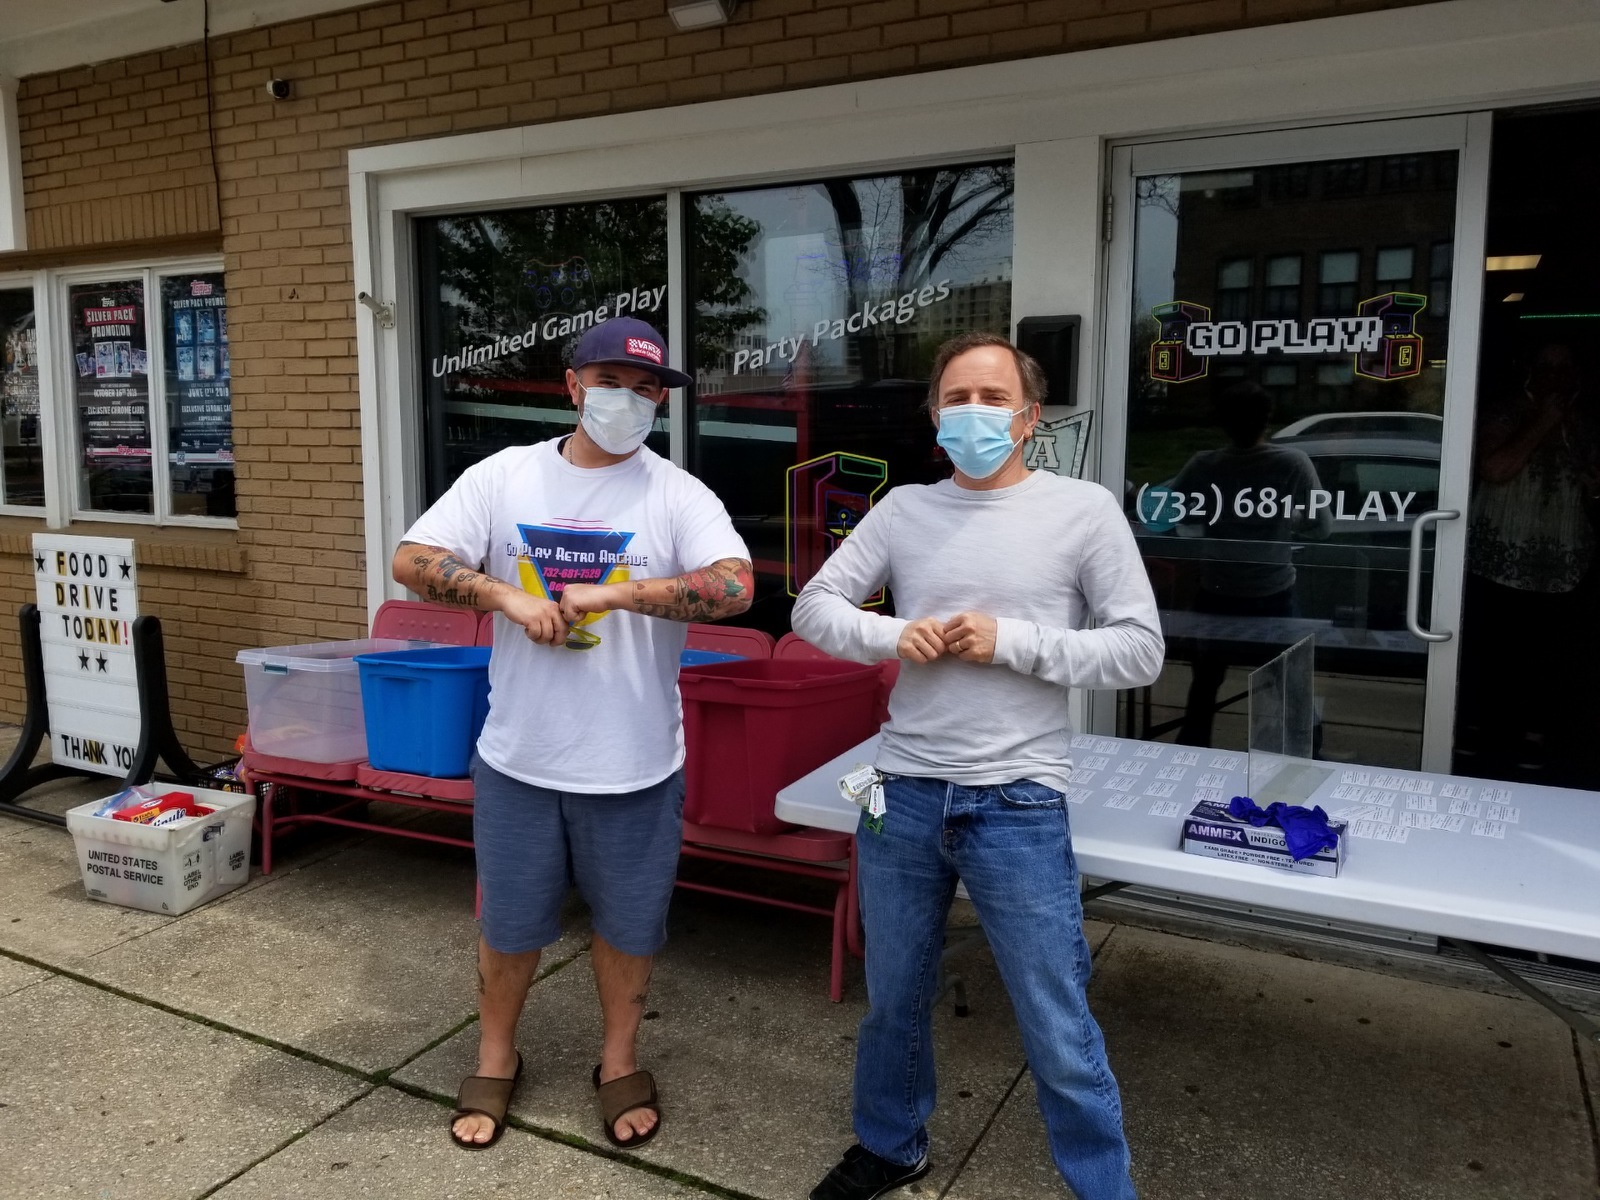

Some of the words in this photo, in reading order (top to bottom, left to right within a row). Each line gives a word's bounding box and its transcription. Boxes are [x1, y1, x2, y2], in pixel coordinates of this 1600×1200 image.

[86, 310, 112, 323] SILVER
[113, 308, 134, 321] PACK
[91, 324, 131, 338] PROMOTION
[431, 322, 536, 378] Unlimited
[542, 304, 608, 341] Game
[614, 284, 668, 317] Play
[733, 332, 804, 376] Party
[812, 278, 950, 347] Packages
[1187, 321, 1247, 356] GO
[1251, 316, 1383, 354] PLAY!
[187, 388, 204, 398] JUNE
[87, 406, 111, 415] EXCLUSIVE
[111, 406, 132, 415] CHROME
[181, 405, 205, 413] EXCLUSIVE
[205, 405, 223, 413] CHROME
[1026, 435, 1060, 469] A
[1136, 482, 1223, 526] (732)
[1233, 487, 1417, 522] 681-PLAY
[56, 551, 108, 578] FOOD
[543, 567, 601, 579] 732-681-7529
[55, 583, 119, 612] DRIVE
[427, 585, 479, 607] DeMott
[61, 615, 129, 646] TODAY!
[61, 734, 108, 765] THANK
[153, 808, 187, 826] inute
[1188, 823, 1243, 842] AMMEX
[1250, 835, 1286, 847] INDIGO
[88, 849, 121, 864] UNITED
[121, 856, 159, 871] STATES
[228, 855, 246, 867] OTHER
[229, 850, 245, 861] LABEL
[1217, 852, 1234, 860] LATEX
[1242, 851, 1267, 859] POWDER
[232, 862, 243, 871] END
[86, 863, 122, 879] POSTAL
[123, 870, 164, 886] SERVICE
[183, 869, 202, 881] LABEL
[183, 874, 203, 887] OTHER
[187, 882, 199, 891] END
